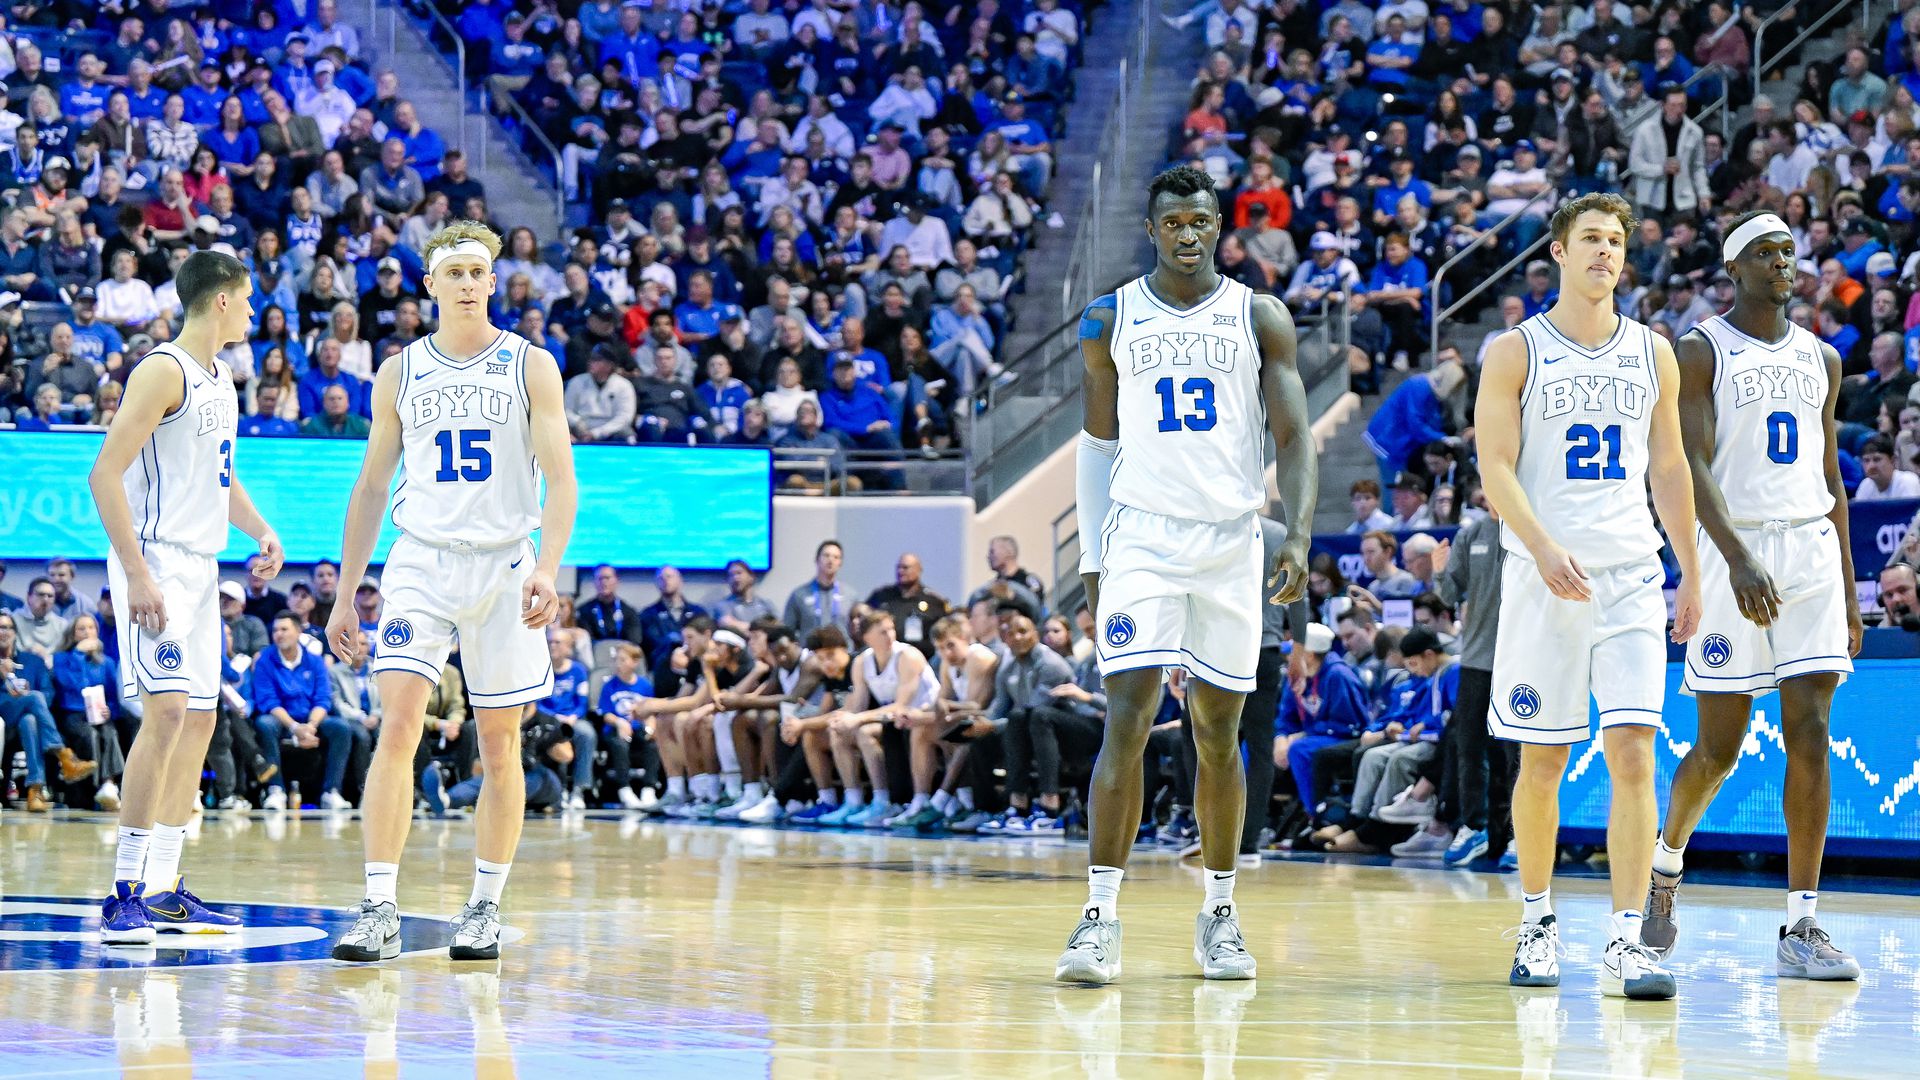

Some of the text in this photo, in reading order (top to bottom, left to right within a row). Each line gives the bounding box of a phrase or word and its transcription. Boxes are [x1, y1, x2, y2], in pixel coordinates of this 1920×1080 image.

[1129, 332, 1238, 376] BYU
[411, 385, 512, 429] BYU
[1155, 377, 1217, 432] 13
[1543, 375, 1646, 420] BYU
[1732, 365, 1820, 409] BYU
[198, 398, 237, 436] BY
[1766, 411, 1798, 464] 0
[219, 439, 231, 487] 3
[434, 429, 492, 482] 15
[1565, 423, 1626, 480] 21
